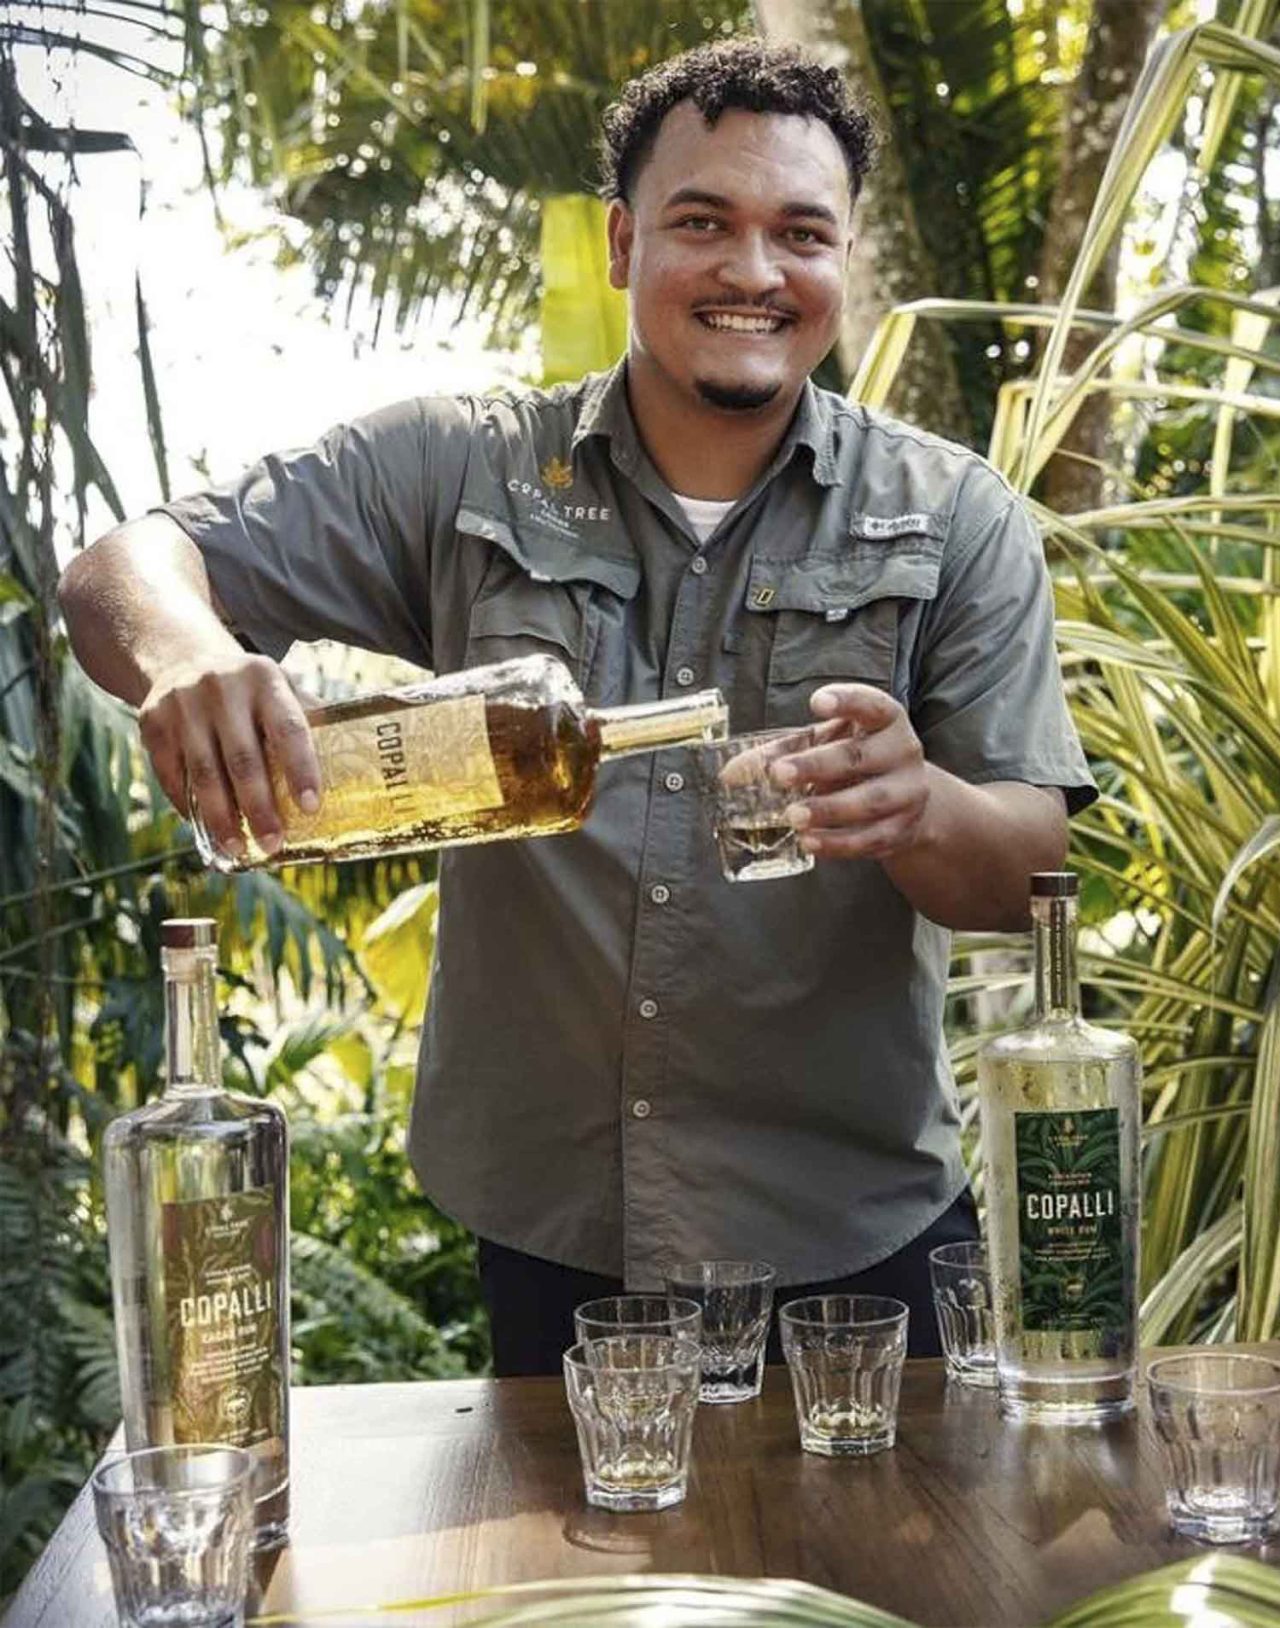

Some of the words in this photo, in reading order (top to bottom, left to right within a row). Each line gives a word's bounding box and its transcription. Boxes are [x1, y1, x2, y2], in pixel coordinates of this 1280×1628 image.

[564, 504, 612, 520] TREE
[377, 722, 416, 815] COPALLI
[1027, 1189, 1114, 1220] COPALLI
[180, 1280, 272, 1328] COPALLI
